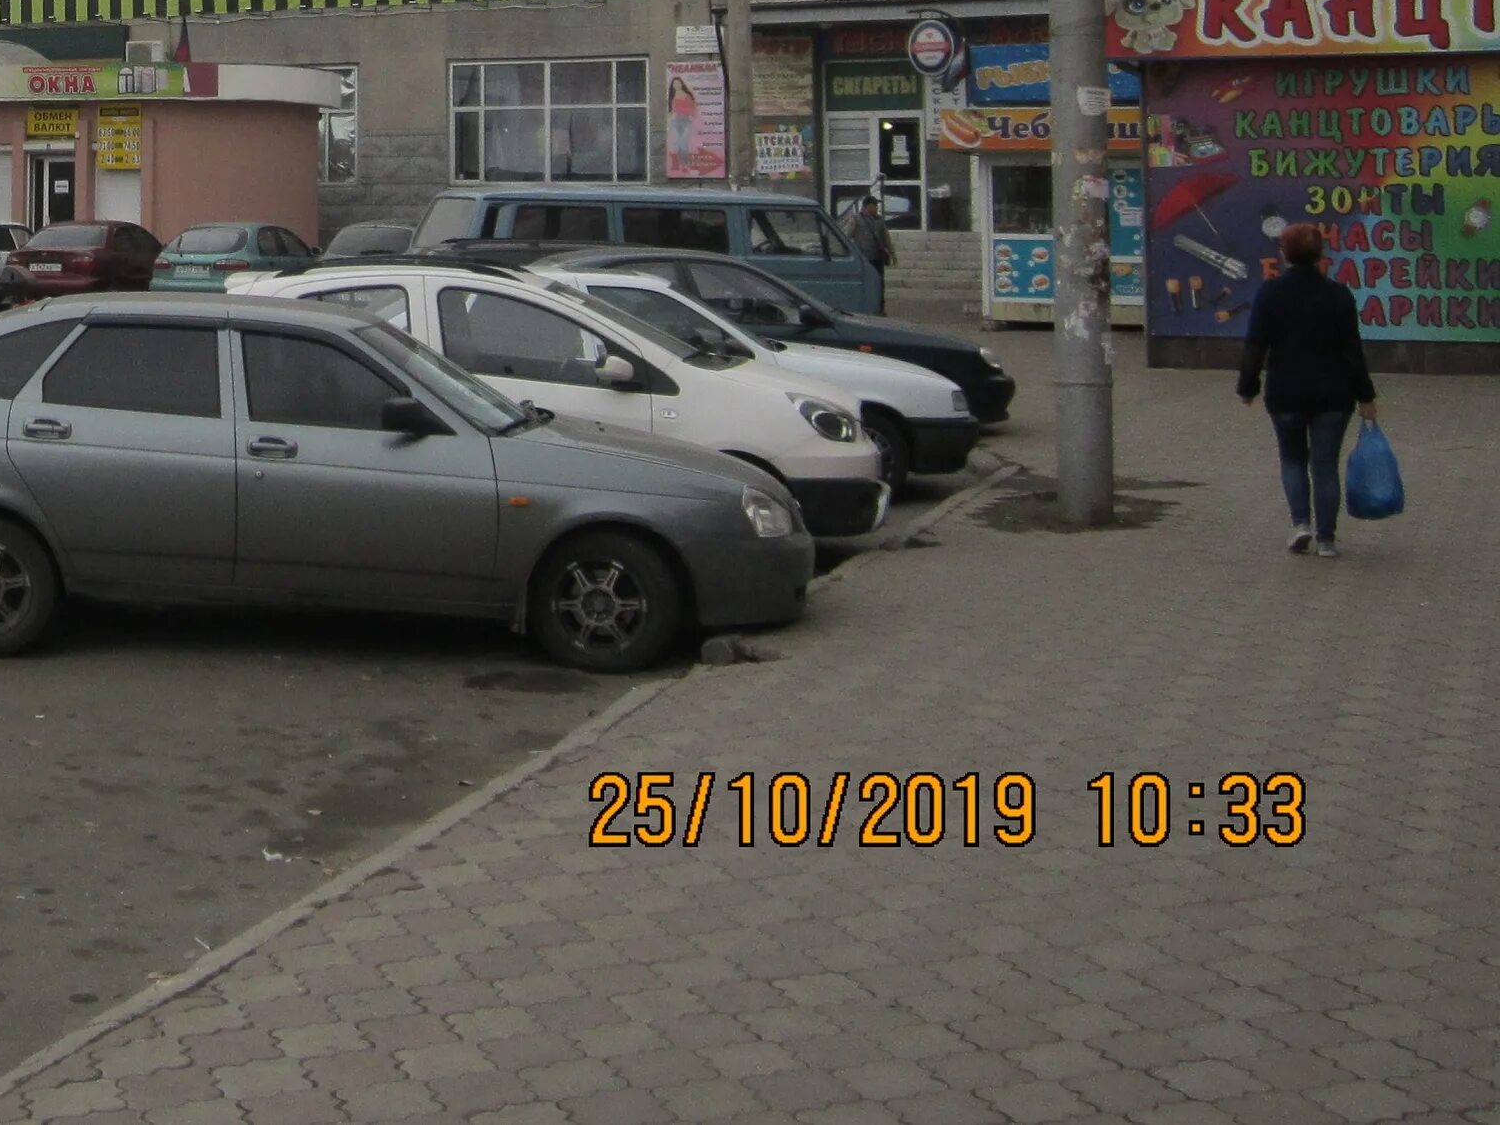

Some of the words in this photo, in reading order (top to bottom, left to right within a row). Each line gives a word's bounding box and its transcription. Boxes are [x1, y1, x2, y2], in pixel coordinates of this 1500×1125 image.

[28, 75, 97, 94] ОКНА
[833, 75, 917, 95] СИГАРЕТЫ
[1275, 65, 1470, 98] ИГРУШКИ
[34, 112, 72, 121] ОБМЕН
[34, 122, 71, 132] ВАЛЮТ
[1248, 144, 1500, 178] БИЖУТЕРИЯ
[1304, 183, 1444, 216] ЗОНТЫ
[1319, 220, 1434, 252] ЧАСЫ
[1260, 253, 1500, 290] БТАРЕЙКИ
[1359, 295, 1500, 329] АРИКИ
